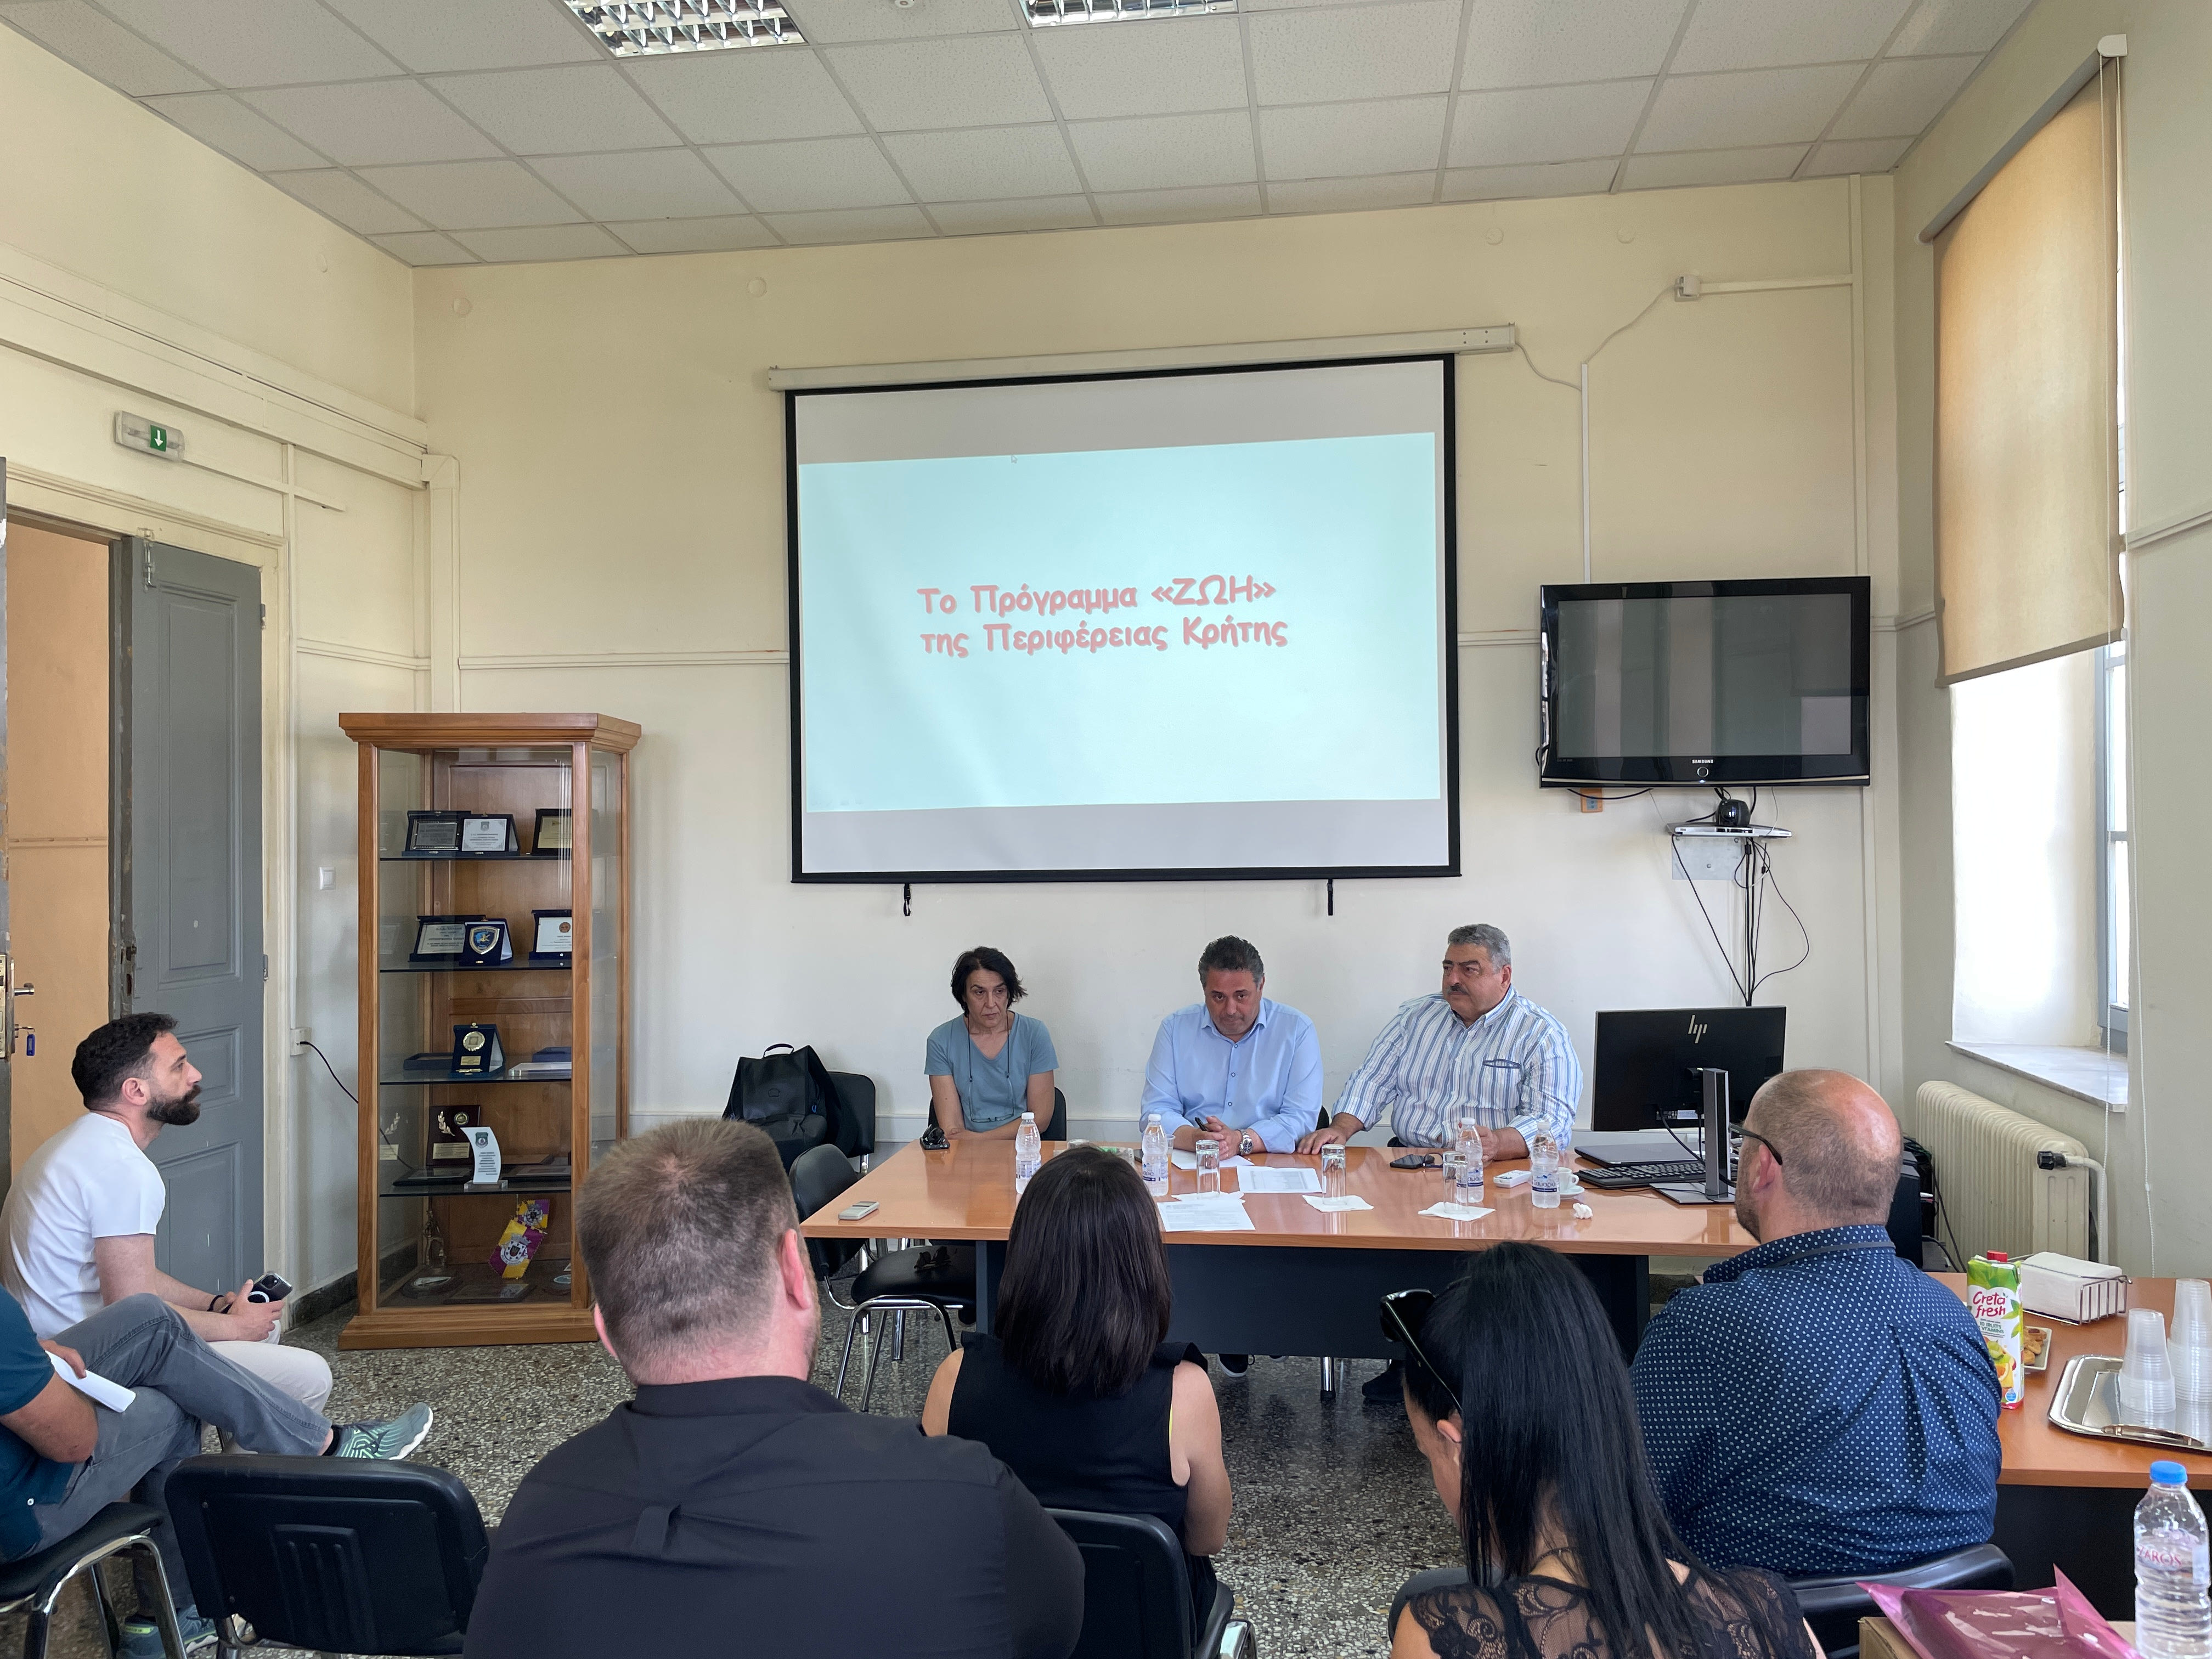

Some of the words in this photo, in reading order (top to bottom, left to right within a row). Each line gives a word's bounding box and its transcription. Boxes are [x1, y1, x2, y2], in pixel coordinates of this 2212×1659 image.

[917, 588, 956, 613] Το
[971, 584, 1136, 616] Πρόγραμμα
[1152, 575, 1274, 605] «ΖΩΗ»
[921, 634, 968, 657] της
[984, 621, 1166, 654] Περιφέρειας
[1183, 616, 1286, 648] Κρήτης
[1688, 1015, 1707, 1043] hp
[1973, 1291, 2006, 1305] Creta
[1975, 1305, 2006, 1318] fresh
